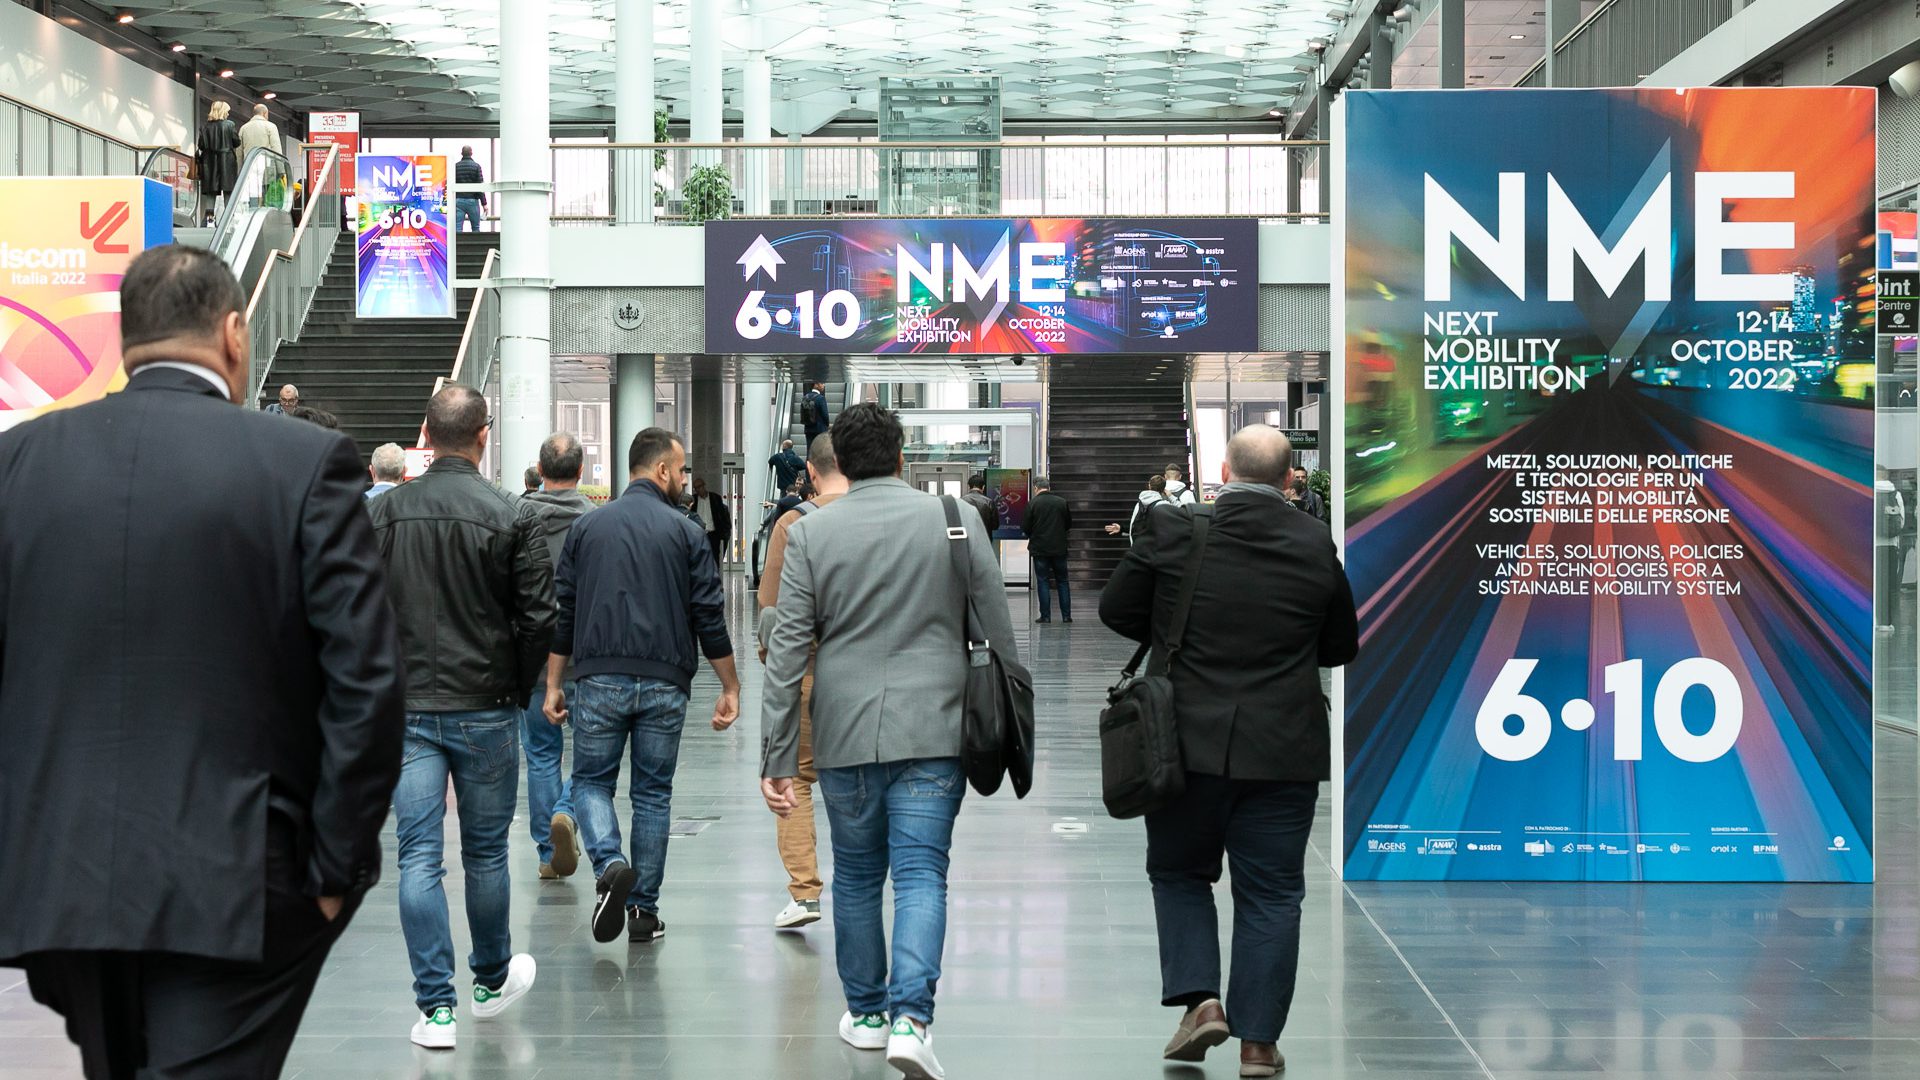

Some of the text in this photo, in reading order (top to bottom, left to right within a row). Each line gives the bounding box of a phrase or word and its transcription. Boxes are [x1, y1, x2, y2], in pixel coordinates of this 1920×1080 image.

[372, 164, 433, 188] NME
[379, 208, 427, 230] 6·10
[1424, 171, 1795, 302] NME
[12, 271, 86, 285] Italia 2022
[896, 242, 1066, 302] NME
[897, 306, 932, 317] NEXT
[1878, 300, 1911, 311] Centre
[735, 289, 861, 340] 6·10
[897, 318, 959, 330] MOBILITY
[1008, 318, 1065, 330] OCTOBER
[1424, 312, 1498, 335] NEXT
[897, 331, 971, 343] EXHIBITION
[1034, 332, 1066, 343] 2022
[1424, 339, 1561, 362] MOBILITY
[1671, 340, 1794, 362] OCTOBER
[1424, 365, 1586, 389] EXHIBITION
[1728, 370, 1794, 391] 2022
[1487, 454, 1733, 471] MEZZI, SOLUZIONI, POLITICHE
[1515, 472, 1704, 487] E TECNOLOGIE PER UN
[1521, 487, 1698, 505] SISTEMA DI MOBILITÀ
[1489, 508, 1730, 523] SOSTENIBILE DELLE PERSONE
[1475, 544, 1744, 561] VEHICLES, SOLUTIONS, POLICIES
[1494, 562, 1725, 577] AND TECHNOLOGIES FOR A
[1478, 580, 1741, 595] SUSTAINABLE MOBILITY SYSTEM
[1475, 657, 1744, 763] 6·10
[1378, 842, 1407, 850] AGENS
[1478, 843, 1502, 851] asstra
